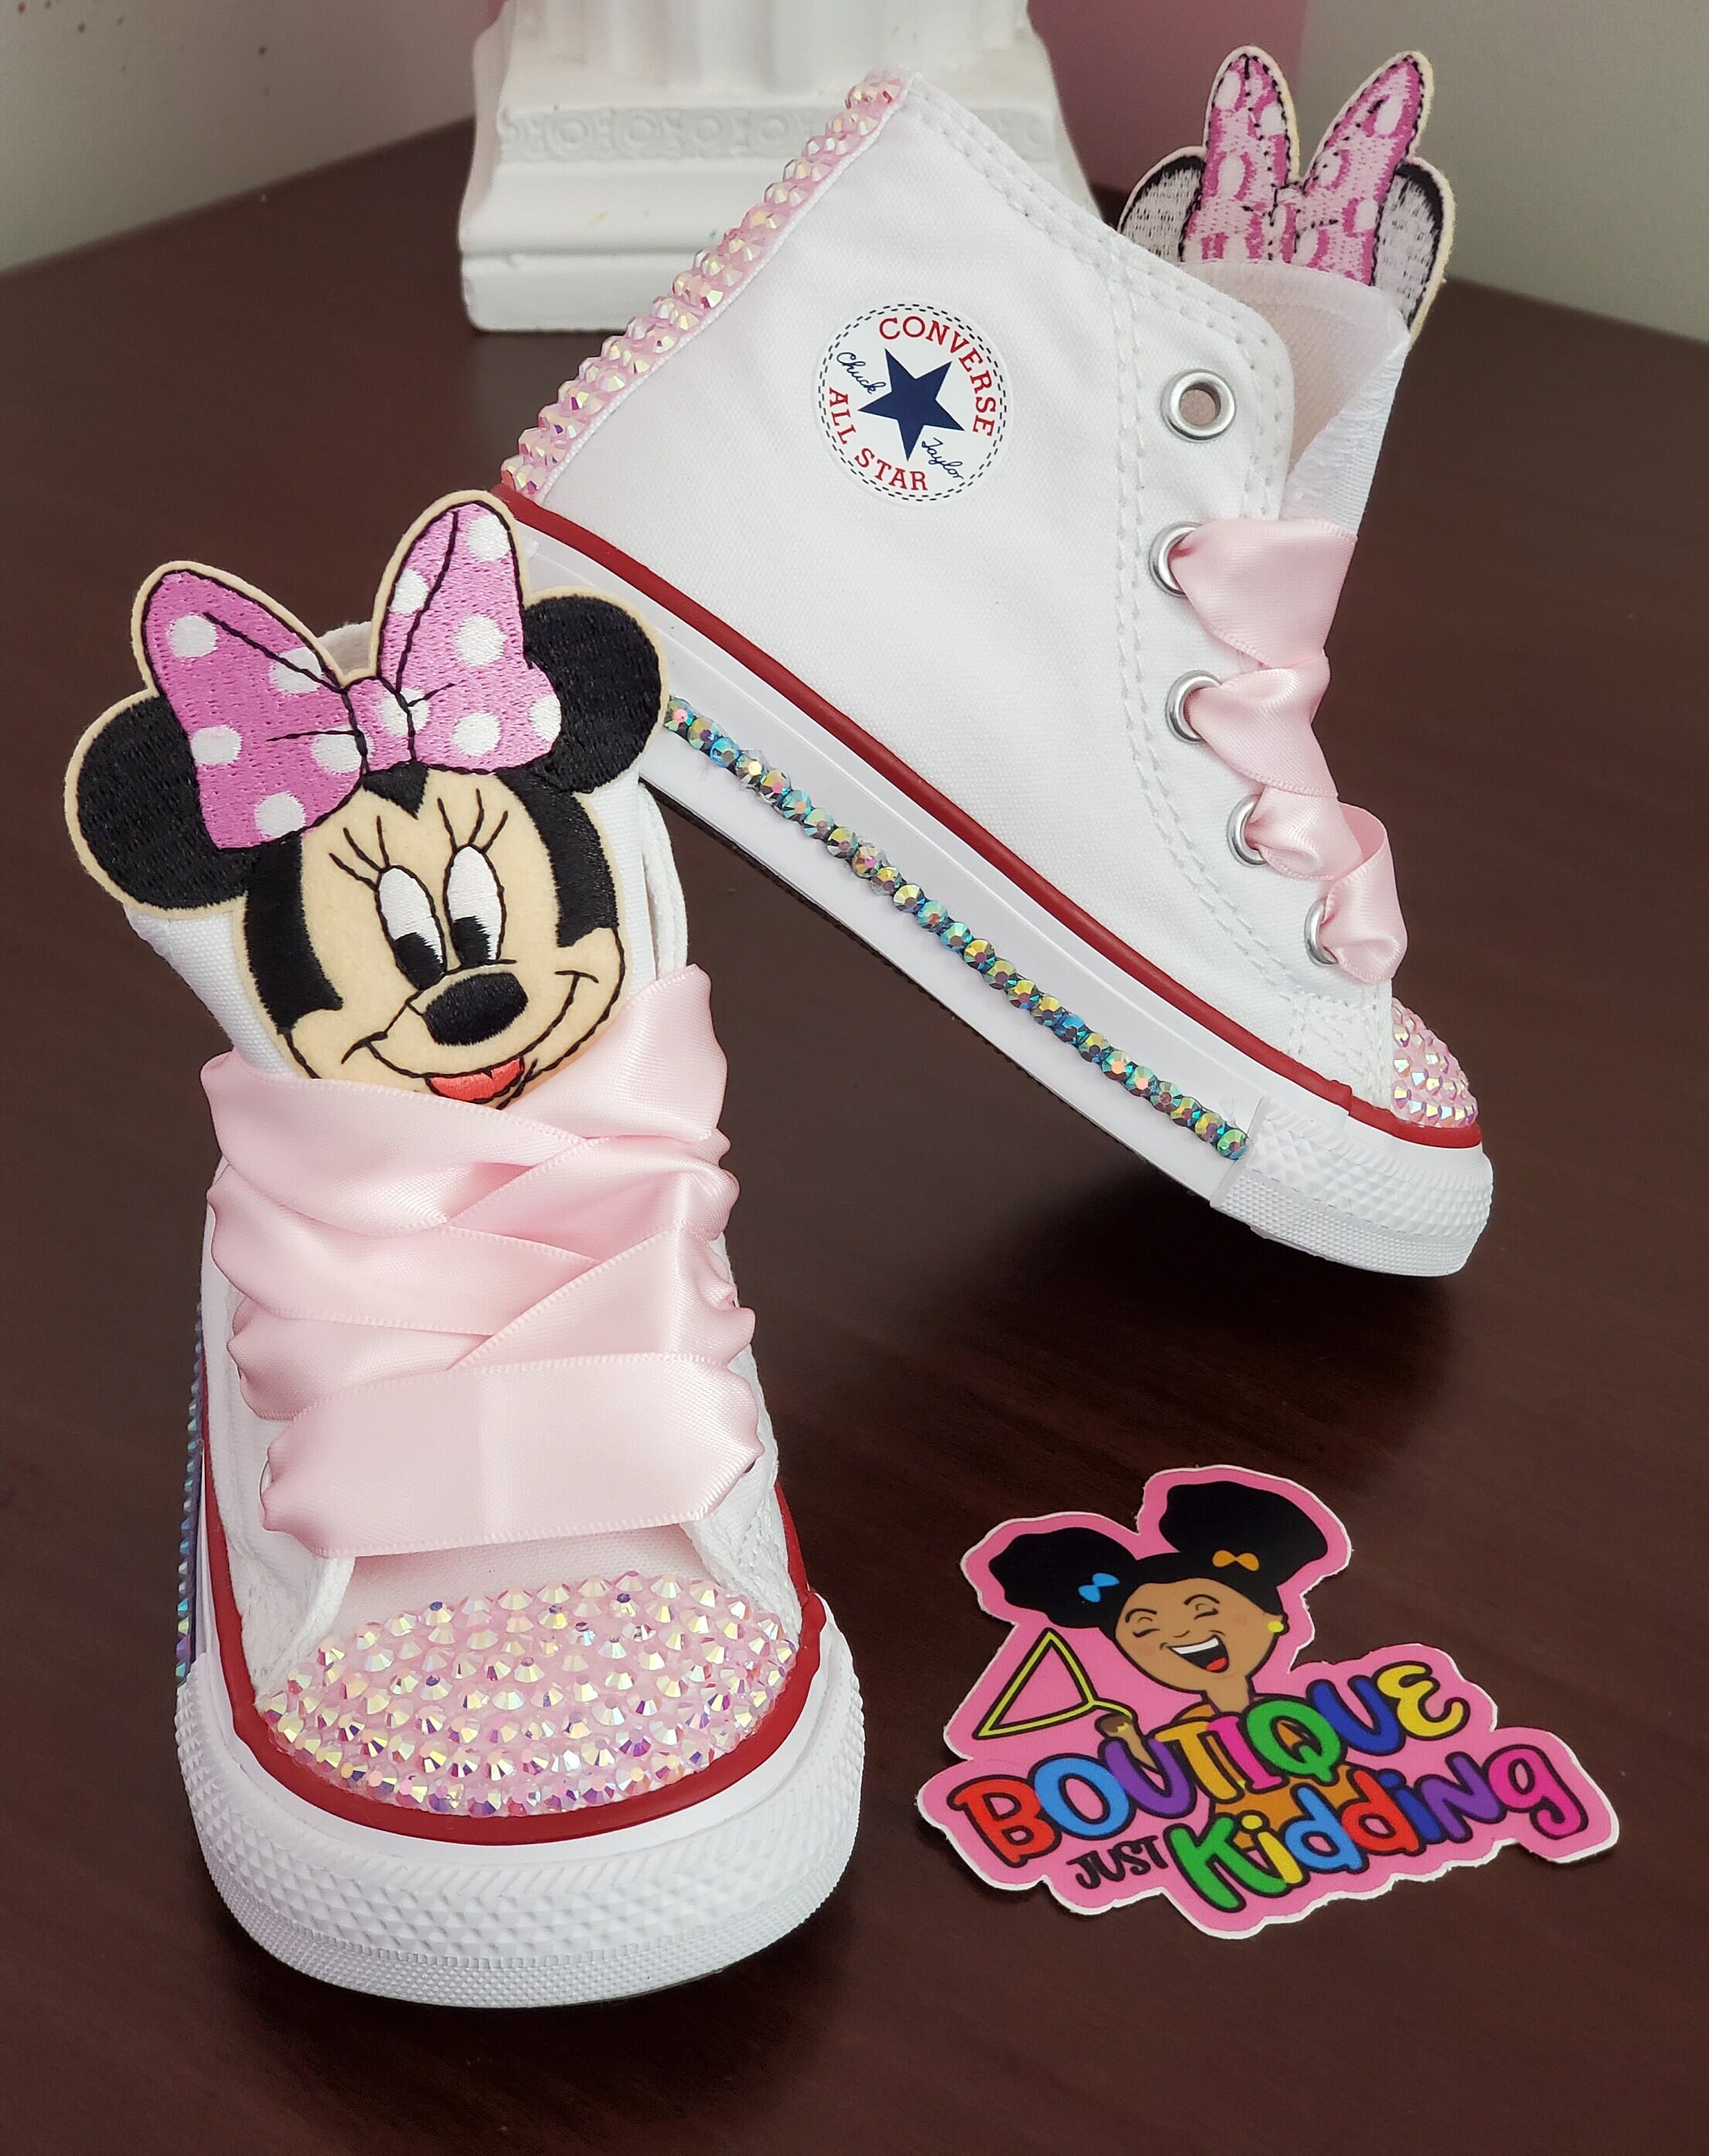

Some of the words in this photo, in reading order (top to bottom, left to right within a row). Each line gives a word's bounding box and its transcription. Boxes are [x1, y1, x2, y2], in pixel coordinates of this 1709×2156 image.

[836, 352, 887, 394] Chuck
[879, 315, 996, 437] CONVERSE
[829, 387, 856, 444] ALL
[854, 448, 928, 491] STAR
[921, 437, 964, 479] Taylor
[948, 1662, 1472, 1865] BOUTIQUE
[1067, 1834, 1171, 1889] JUST
